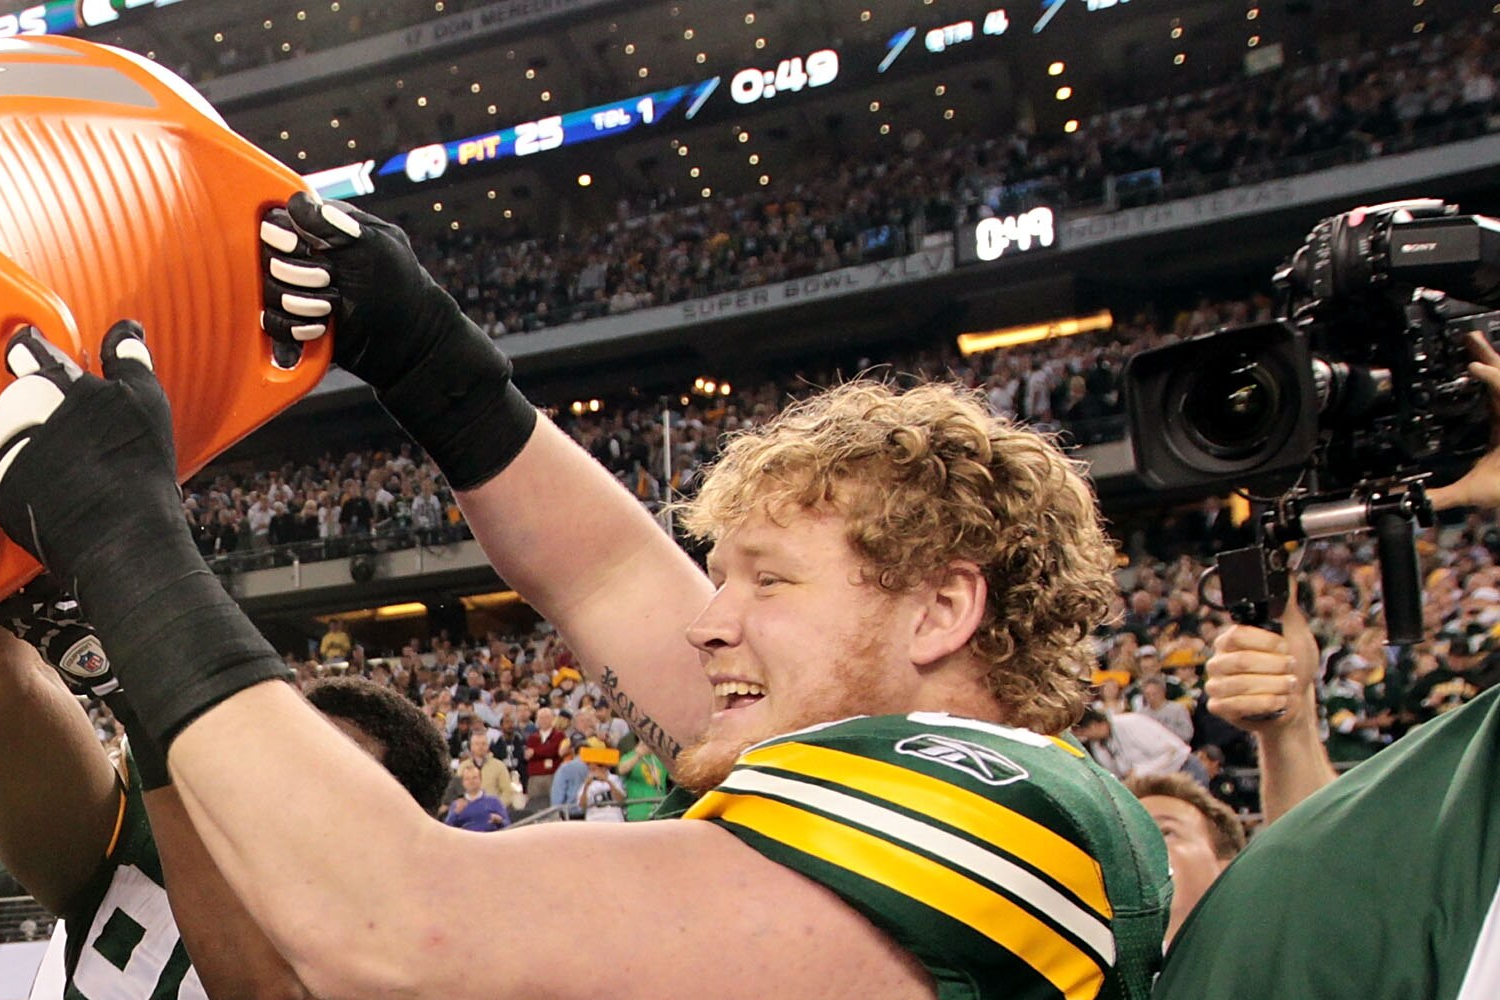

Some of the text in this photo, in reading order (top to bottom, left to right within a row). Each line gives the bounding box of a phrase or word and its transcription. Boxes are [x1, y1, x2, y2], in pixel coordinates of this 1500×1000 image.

[730, 49, 839, 104] 0:49
[982, 8, 1009, 36] 4
[458, 134, 501, 165] PIT
[515, 115, 564, 157] 25
[636, 97, 654, 124] 1
[682, 248, 946, 322] SUPER BOWL XLV
